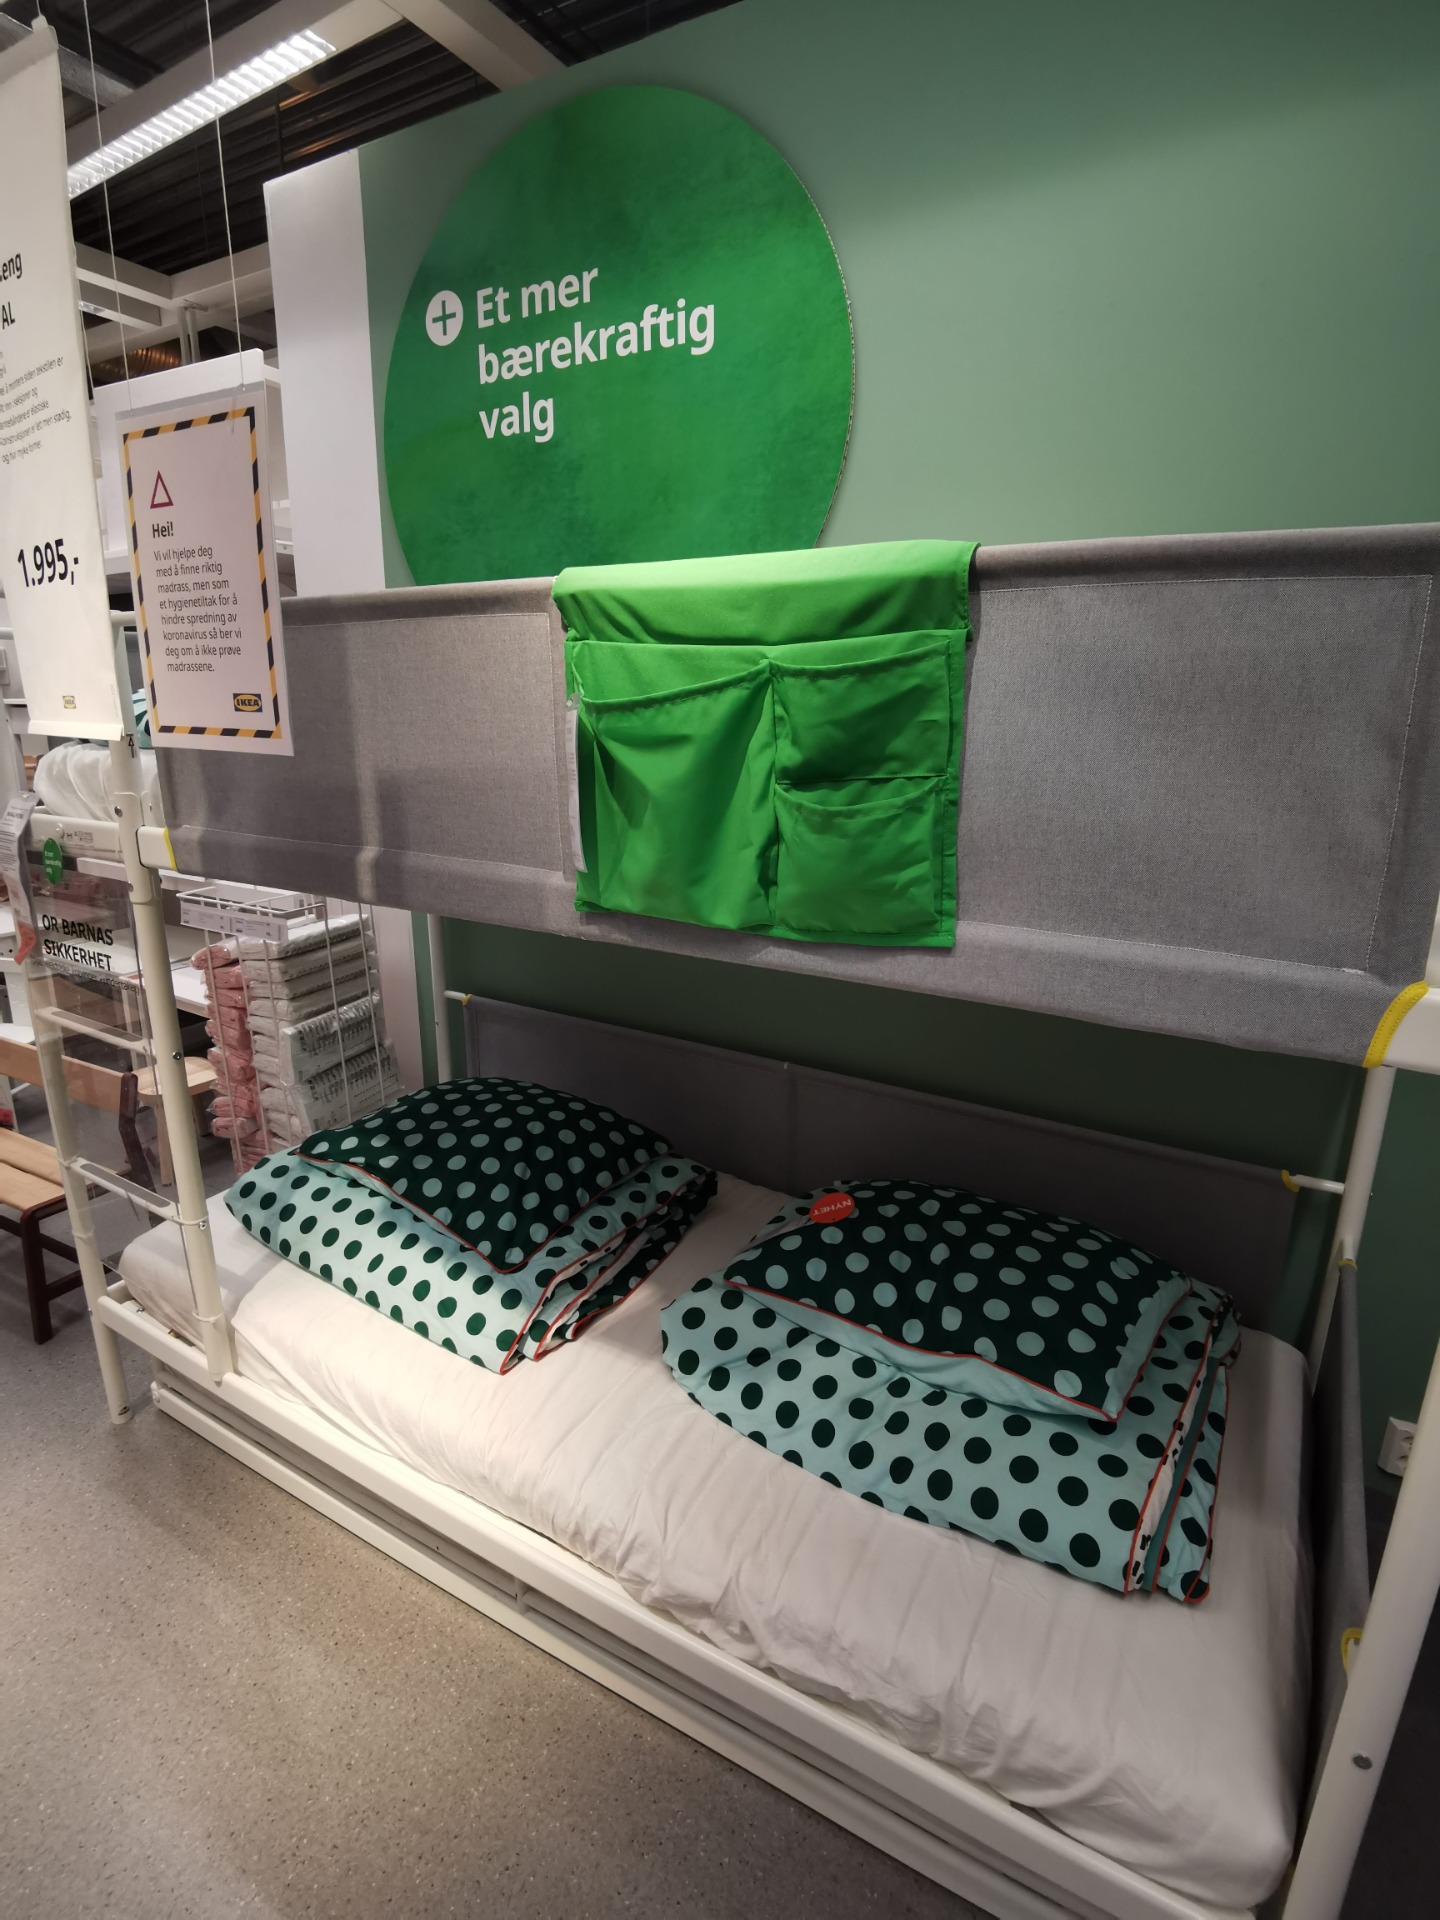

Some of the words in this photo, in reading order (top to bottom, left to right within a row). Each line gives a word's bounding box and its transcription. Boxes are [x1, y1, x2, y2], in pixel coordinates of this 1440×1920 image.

[476, 286, 511, 329] Et
[521, 267, 599, 319] mer
[478, 298, 715, 385] bærekraftig
[478, 391, 555, 443] valg
[152, 521, 174, 539] Hei!
[154, 550, 162, 561] Vi
[162, 549, 171, 561] vil
[172, 547, 196, 562] hjelpe
[197, 545, 213, 560] deg
[18, 538, 79, 588] 1.995,-
[156, 566, 173, 577] med
[174, 564, 179, 576] å
[180, 563, 200, 576] finne
[201, 561, 223, 576] riktig
[157, 581, 192, 593] madrass,
[192, 581, 211, 591] men
[212, 579, 230, 590] som
[159, 601, 167, 610] et
[168, 595, 218, 612] hygienetiltak
[218, 593, 230, 606] for
[232, 592, 238, 605] å
[161, 613, 186, 625] hindre
[186, 611, 226, 627] spredning
[227, 613, 238, 623] av
[163, 628, 208, 641] koronavirus
[209, 627, 218, 639] så
[219, 628, 233, 639] ber
[234, 627, 242, 639] vi
[165, 645, 180, 659] deg
[181, 647, 194, 656] om
[195, 644, 200, 656] å
[201, 644, 217, 656] ikke
[219, 646, 242, 659] prøve
[167, 661, 215, 672] madrassene.
[236, 698, 260, 707] IKEA
[42, 914, 59, 934] OR
[61, 918, 114, 946] BARNAS
[43, 938, 112, 971] SIKKERHET
[813, 1199, 852, 1216] NYHET
